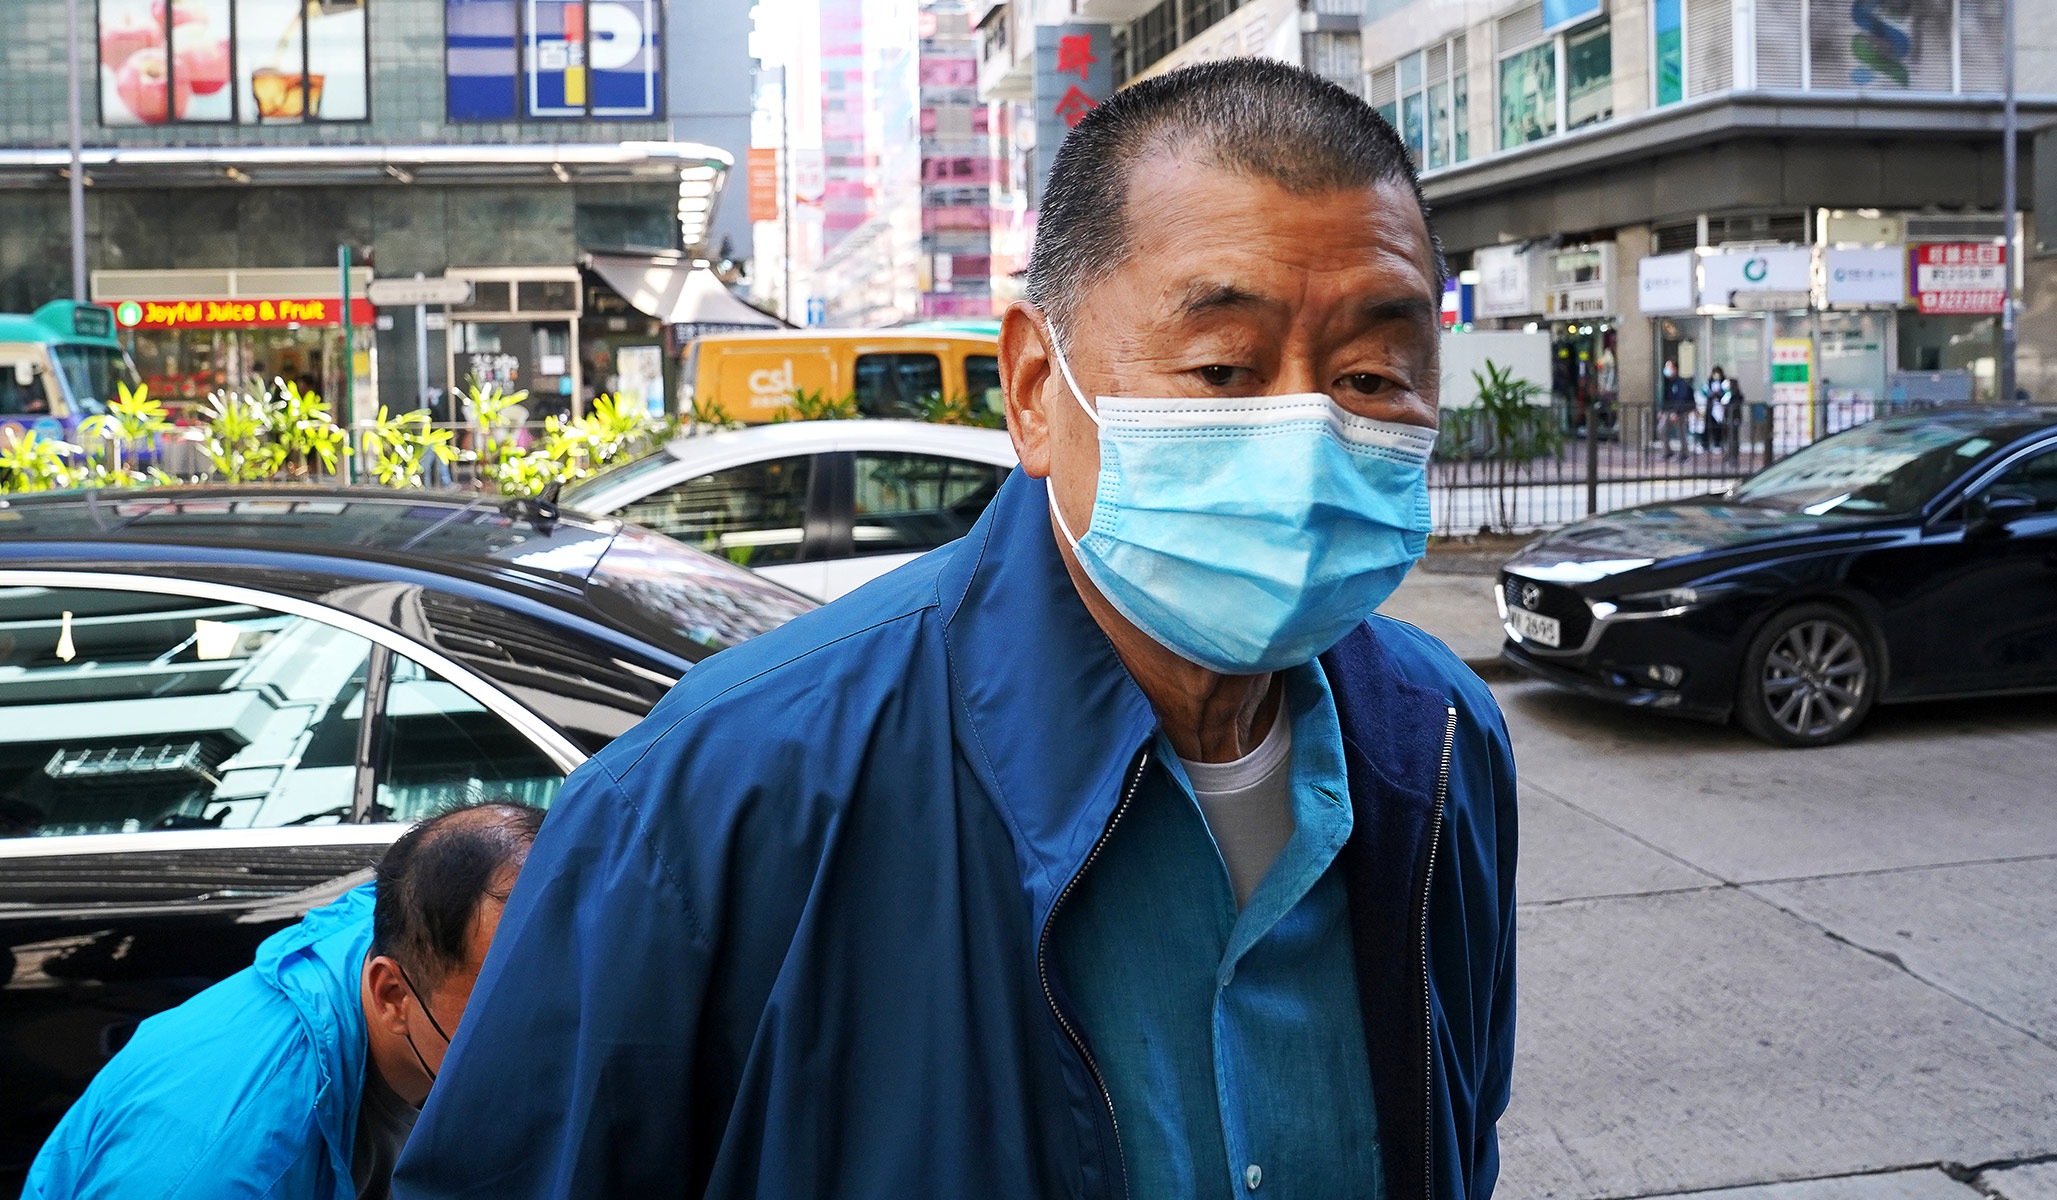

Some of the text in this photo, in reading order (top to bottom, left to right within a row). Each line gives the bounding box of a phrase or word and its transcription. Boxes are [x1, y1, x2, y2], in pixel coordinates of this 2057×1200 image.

[145, 300, 325, 325] Joyful Juice & Fruit
[749, 360, 793, 394] csl
